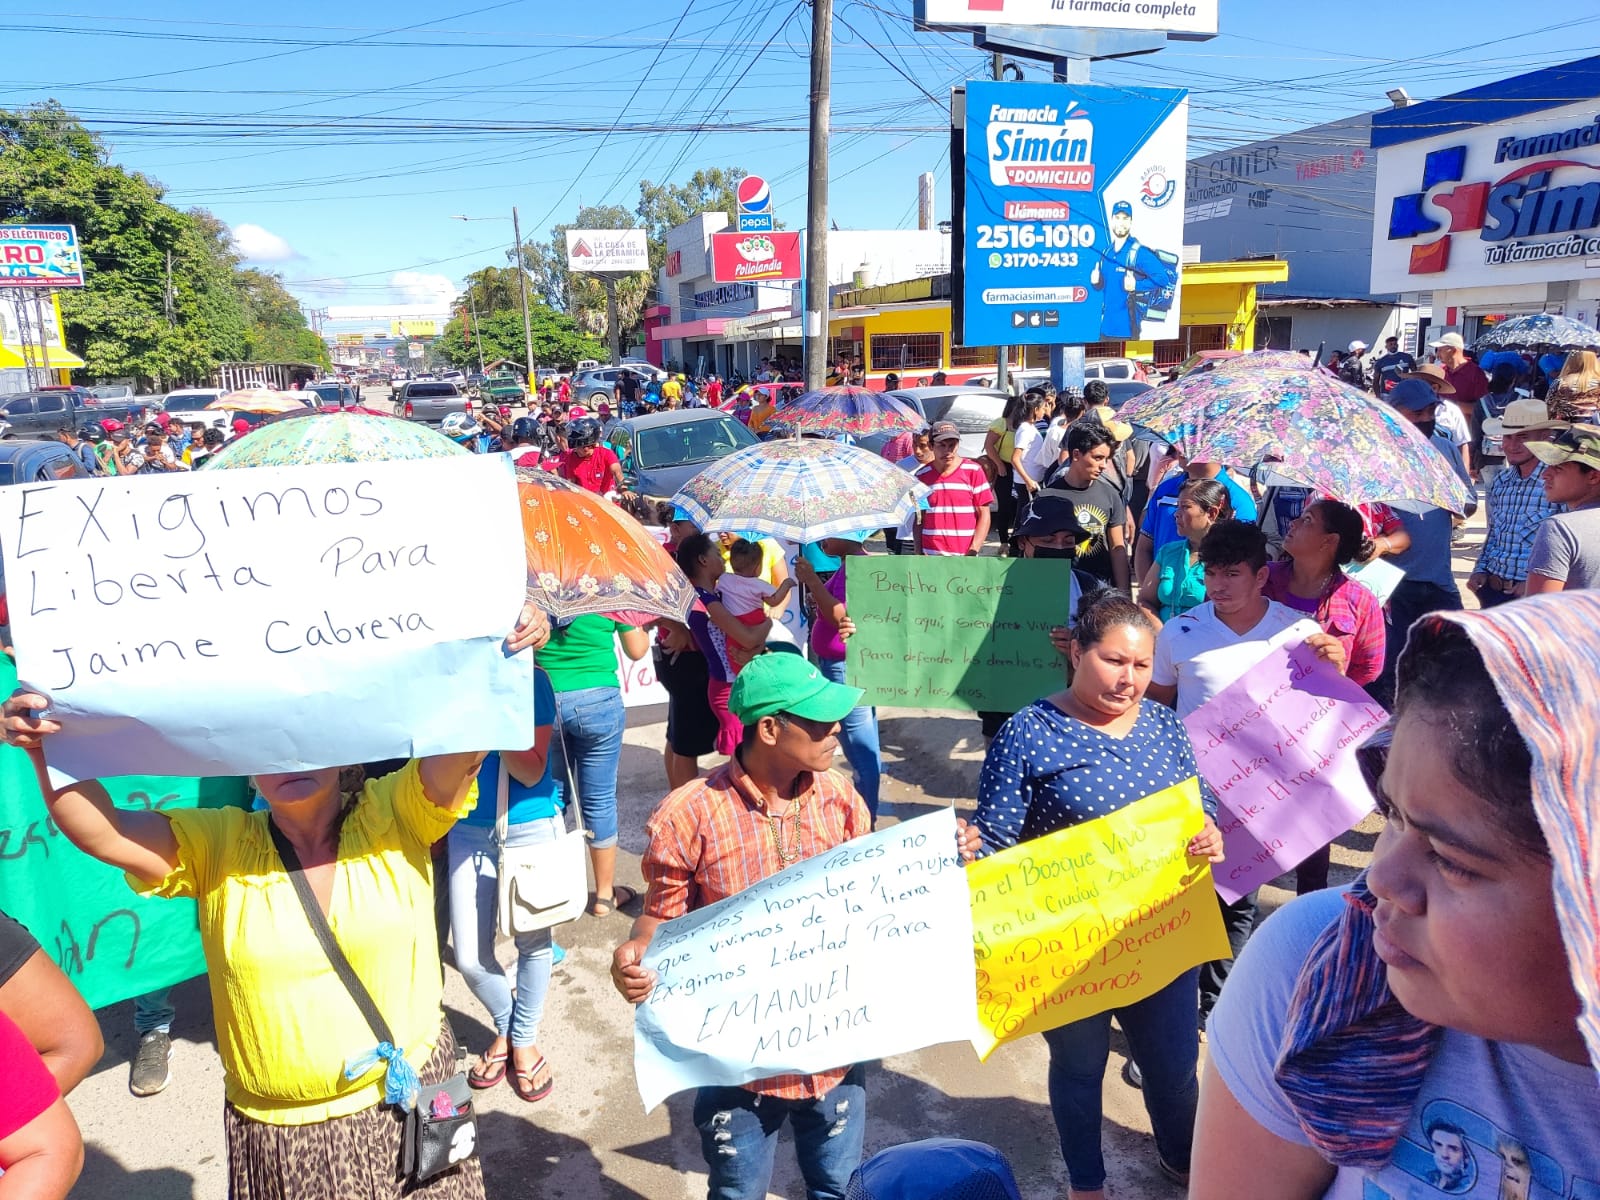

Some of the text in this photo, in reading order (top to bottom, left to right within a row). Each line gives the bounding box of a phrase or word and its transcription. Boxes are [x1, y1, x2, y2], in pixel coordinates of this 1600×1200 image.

[1134, 1, 1197, 19] completa
[989, 103, 1058, 123] Farmacia
[992, 128, 1088, 163] Simán
[1014, 169, 1092, 186] DOMICILIO
[1208, 146, 1278, 184] CENTER
[1189, 181, 1238, 203] AUTORIZADO
[741, 216, 771, 230] pepsi
[1008, 203, 1066, 220] Llámanos
[976, 224, 1096, 249] 2516-1010
[1504, 235, 1583, 263] farmacia
[0, 245, 44, 264] RO
[734, 259, 783, 277] Pollolandia
[1003, 252, 1079, 268] 3170-7433
[985, 288, 1072, 303] farmaciasiman.com
[31, 536, 437, 616] Liberta Para
[870, 571, 937, 592] Bertha
[862, 606, 902, 624] está
[51, 610, 435, 691] Jaime Cabrera
[1206, 682, 1292, 749] defensores
[1294, 659, 1313, 681] de
[1296, 698, 1336, 736] medio
[1266, 779, 1291, 801] El
[1336, 706, 1388, 750] ambiente
[823, 844, 886, 869] Peces
[902, 834, 927, 848] no
[996, 873, 1013, 895] el
[1018, 852, 1096, 886] Bosque
[1102, 826, 1146, 855] Vivo
[763, 876, 857, 914] hombre
[992, 921, 1012, 936] en
[1045, 880, 1100, 914] Ciudad
[657, 884, 931, 977] que vivimos de la tierra
[650, 913, 932, 1005] Exigimos Libertad Para
[1015, 974, 1042, 993] de
[1095, 907, 1191, 966] Derechos
